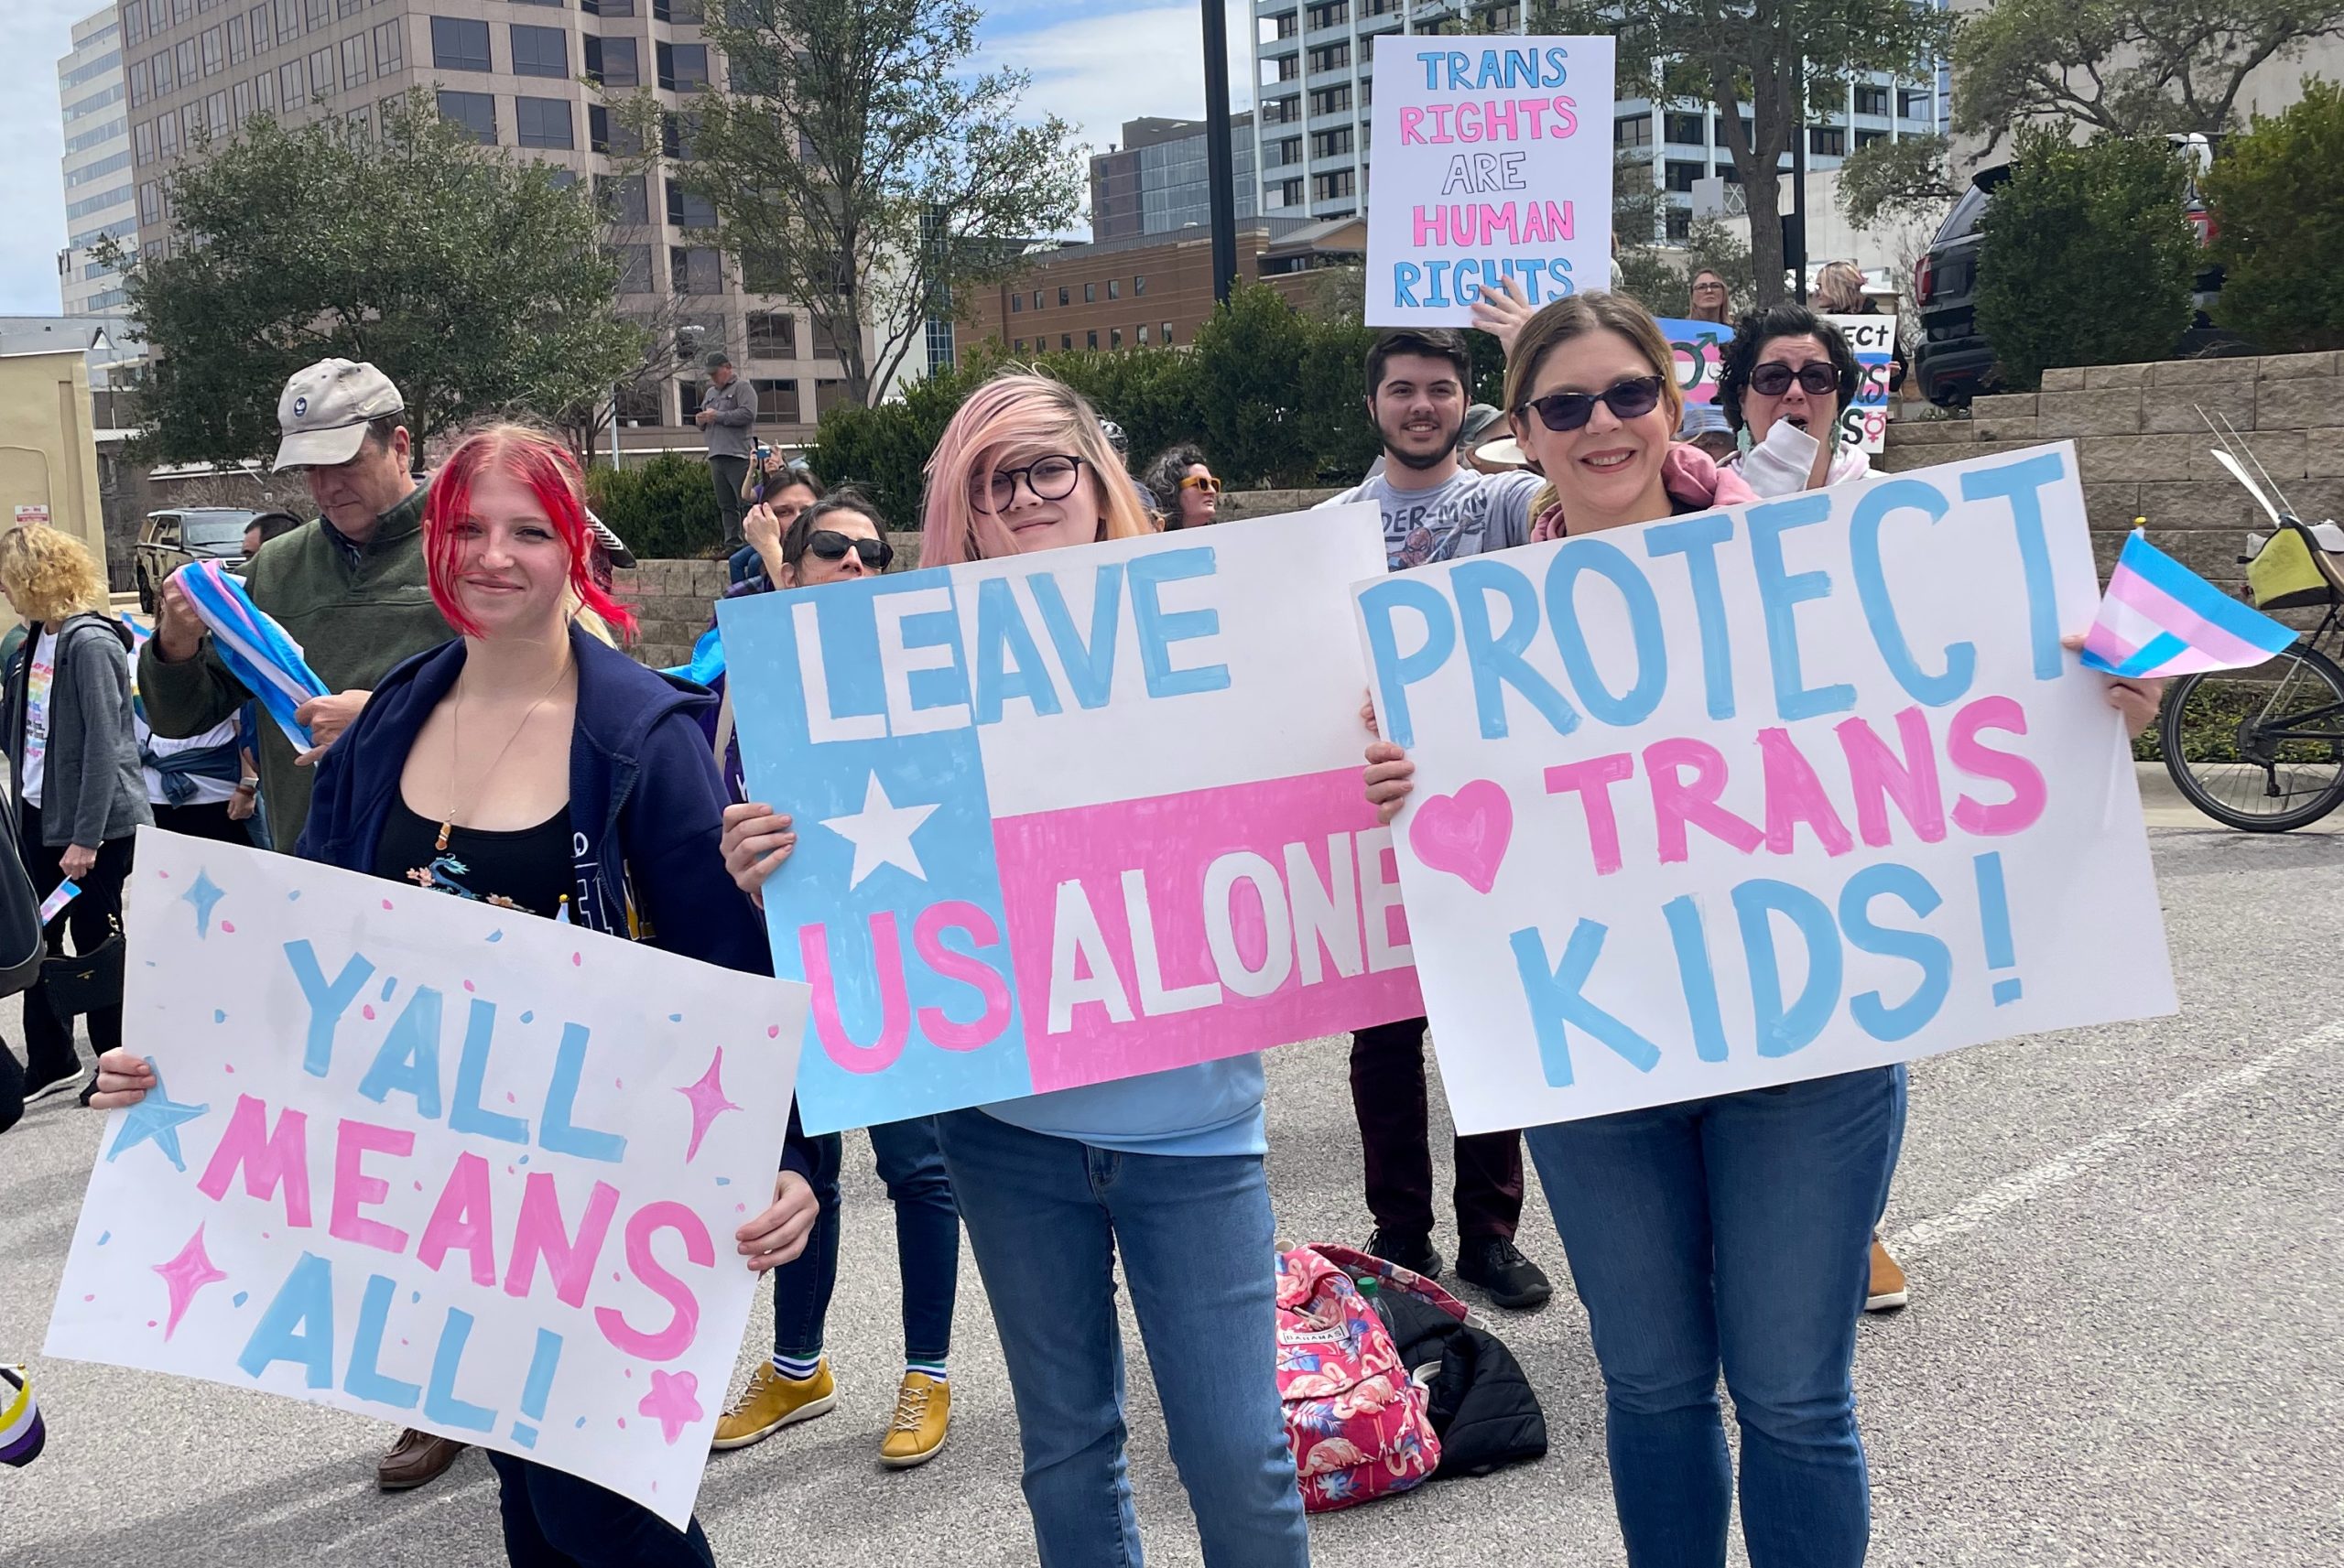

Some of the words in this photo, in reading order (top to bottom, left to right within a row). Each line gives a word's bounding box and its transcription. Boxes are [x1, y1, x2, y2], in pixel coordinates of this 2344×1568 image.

[1400, 96, 1578, 145] RIGHTS
[1416, 47, 1568, 92] TRANS
[1413, 200, 1575, 247] HUMAN
[1441, 151, 1527, 196] ARE
[790, 546, 1232, 744] LEAVE
[1358, 452, 2066, 749] PROTECT
[1544, 695, 2047, 876] TRANS
[798, 900, 1014, 1075] US
[1047, 827, 1416, 1034] ALONE
[1509, 850, 2023, 1089] KIDS!
[283, 938, 627, 1163] Y'ALL
[196, 1094, 716, 1362] MEANS
[236, 1251, 563, 1450] ALL!
